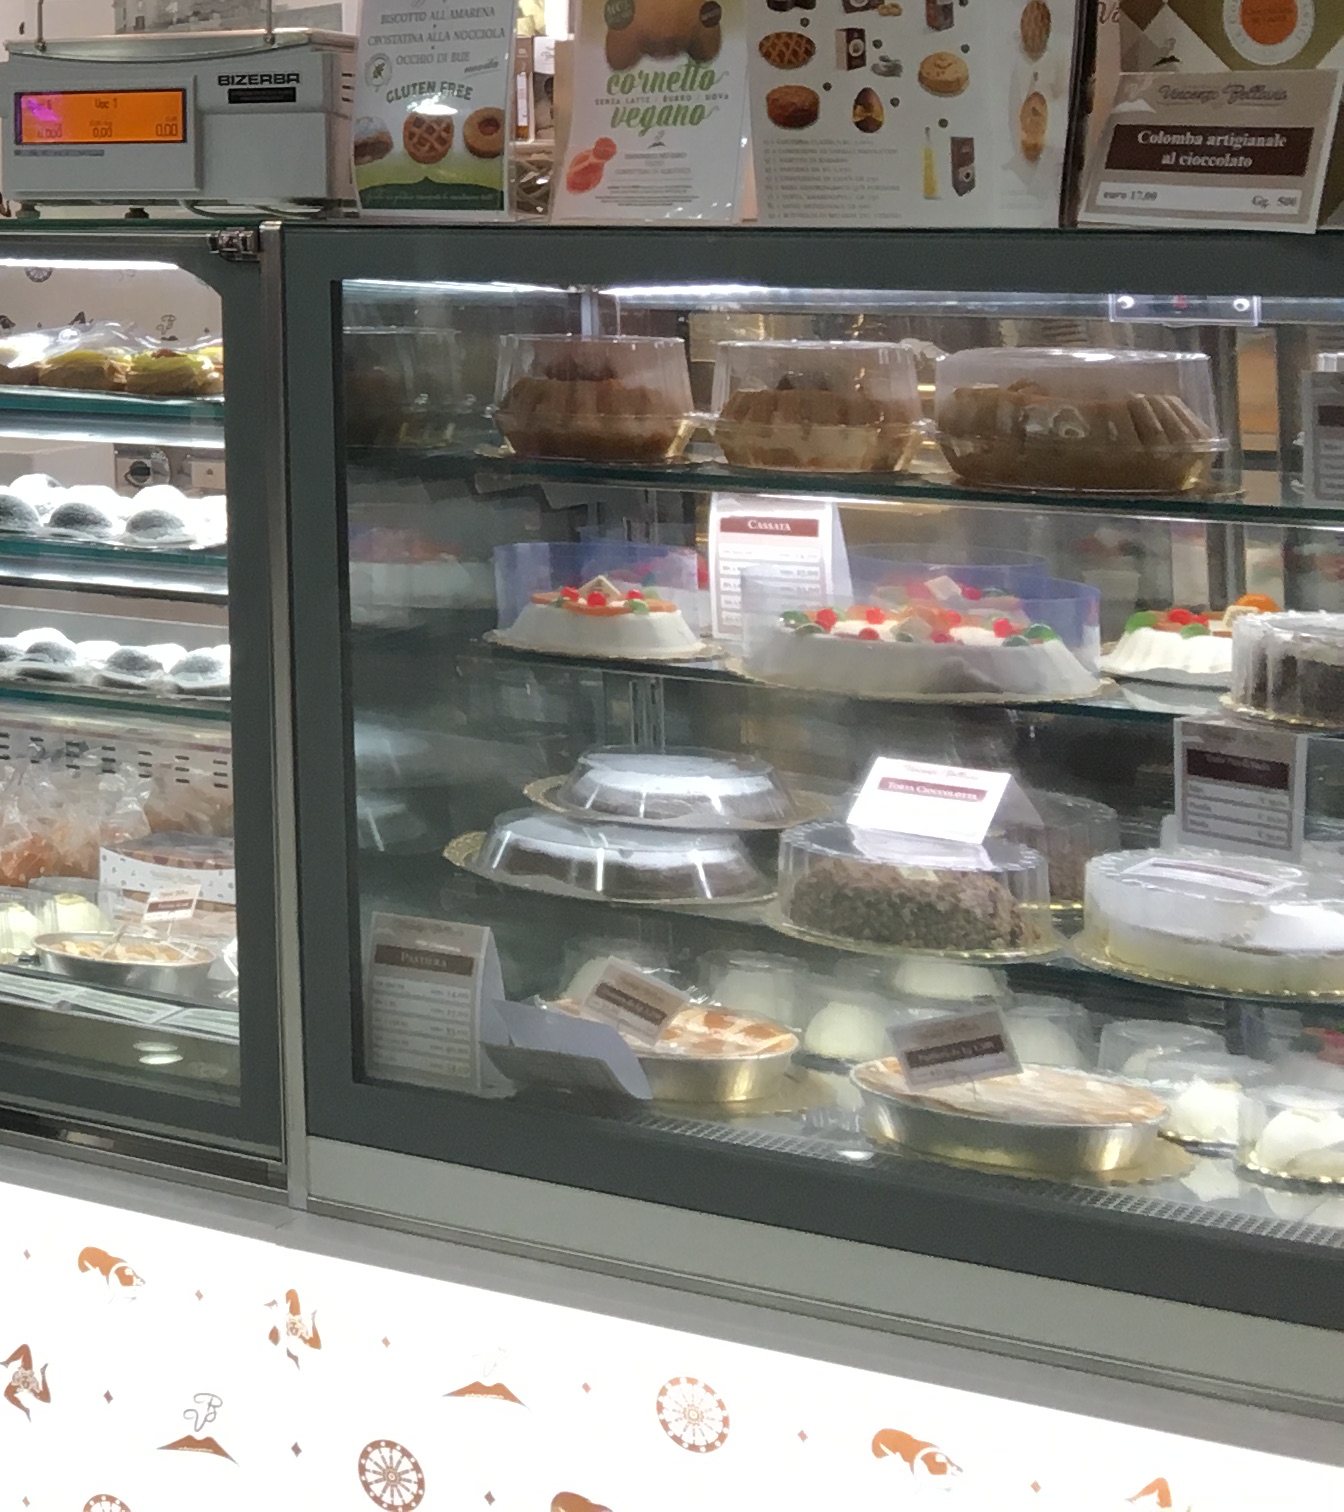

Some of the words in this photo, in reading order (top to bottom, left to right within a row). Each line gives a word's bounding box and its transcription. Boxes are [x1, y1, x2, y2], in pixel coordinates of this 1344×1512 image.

[427, 31, 451, 42] ALLA
[218, 73, 300, 86] BIZERBA
[606, 59, 729, 96] cornetto
[386, 81, 436, 103] GLUTEN
[441, 81, 473, 101] FREE
[611, 104, 719, 137] vegano
[1137, 130, 1203, 146] Colomba
[1206, 132, 1286, 150] artigianale
[1162, 152, 1176, 165] al
[1179, 152, 1253, 168] cioccolato
